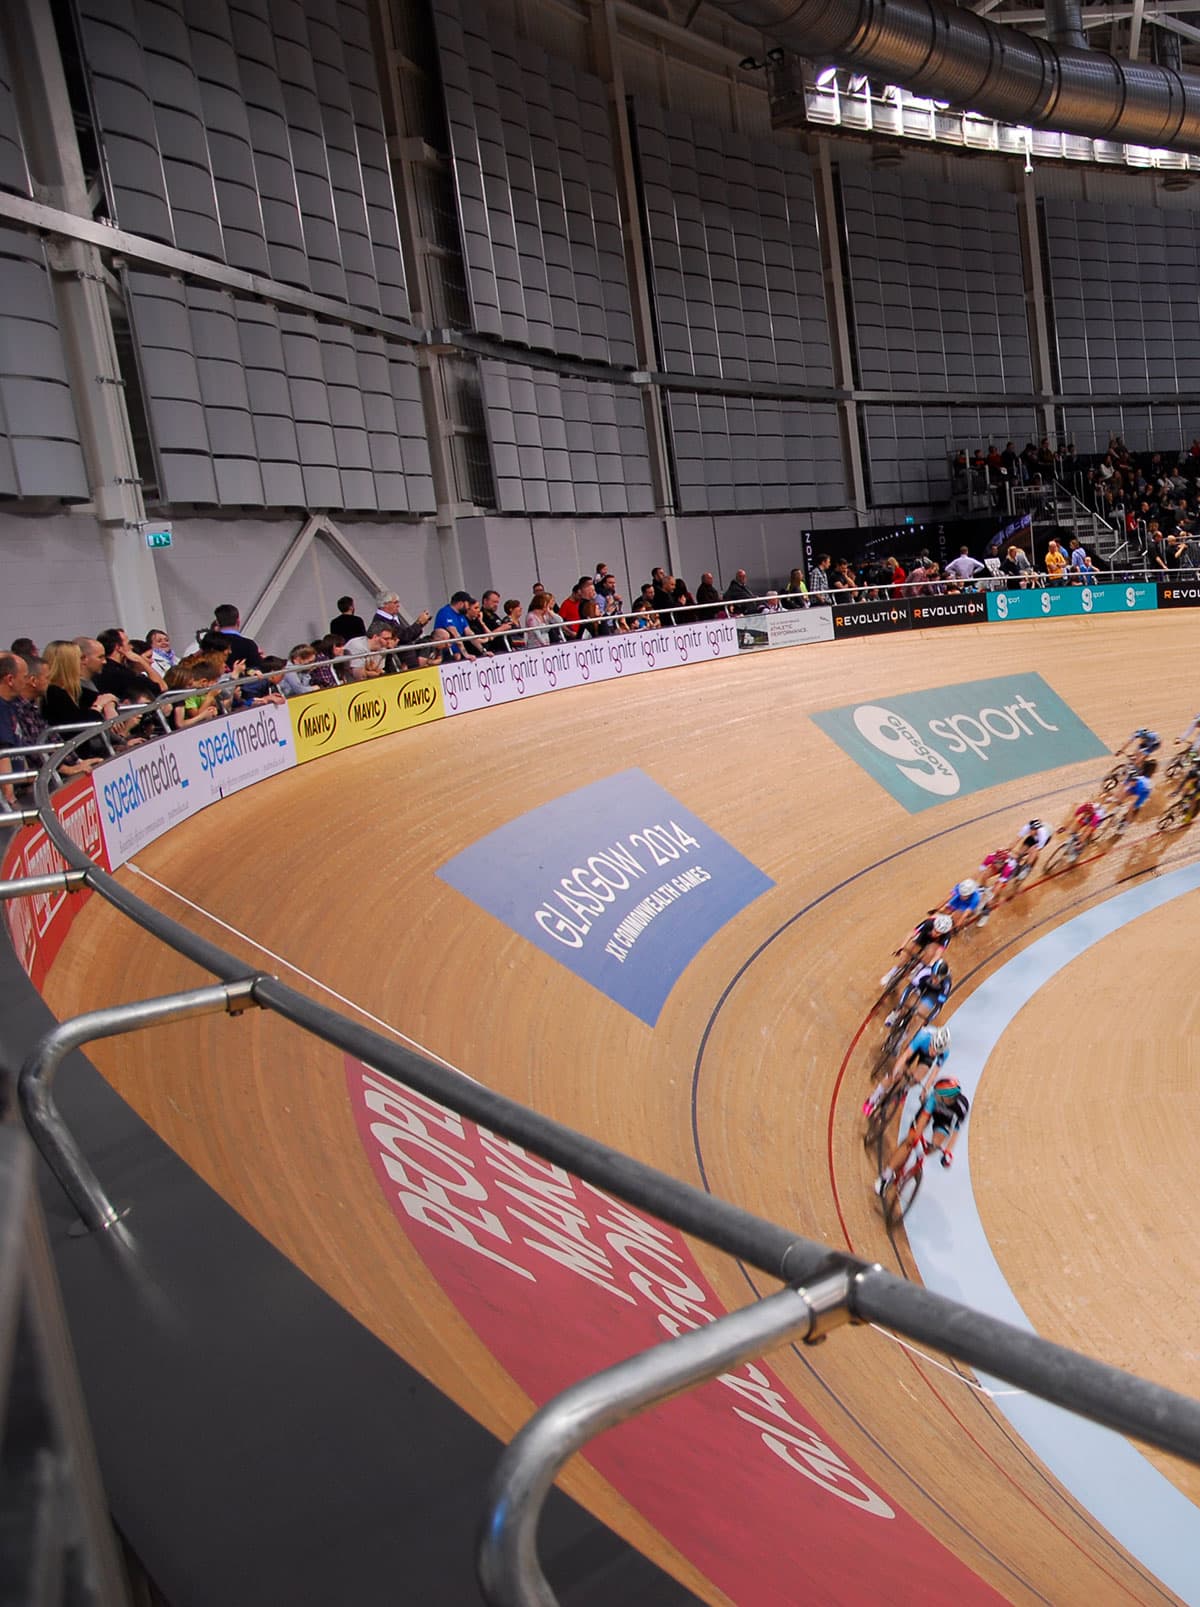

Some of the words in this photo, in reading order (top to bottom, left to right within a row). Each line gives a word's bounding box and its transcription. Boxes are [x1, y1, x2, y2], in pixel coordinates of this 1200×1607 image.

[835, 609, 908, 628] REVOLUTION
[913, 602, 985, 620] REVOLUTION
[606, 636, 638, 674] ignitr
[640, 631, 671, 668] ignitr
[673, 626, 703, 662] ignitr
[706, 623, 735, 656] ignitr
[508, 653, 539, 695] ignitr
[541, 648, 572, 687] ignitr
[573, 642, 605, 680] ignitr
[403, 687, 431, 710] MAVIC
[440, 665, 473, 711] ignitr
[474, 659, 507, 702] ignitr
[303, 714, 331, 738] MAVIC
[353, 699, 381, 723] MAVIC
[928, 694, 1060, 761] sport
[886, 714, 953, 777] Glasgow
[534, 841, 648, 949] GLASGOW
[629, 819, 702, 867] 2014
[671, 865, 712, 893] GAMES
[612, 882, 682, 948] COMMONWEALTH
[604, 938, 629, 964] XX
